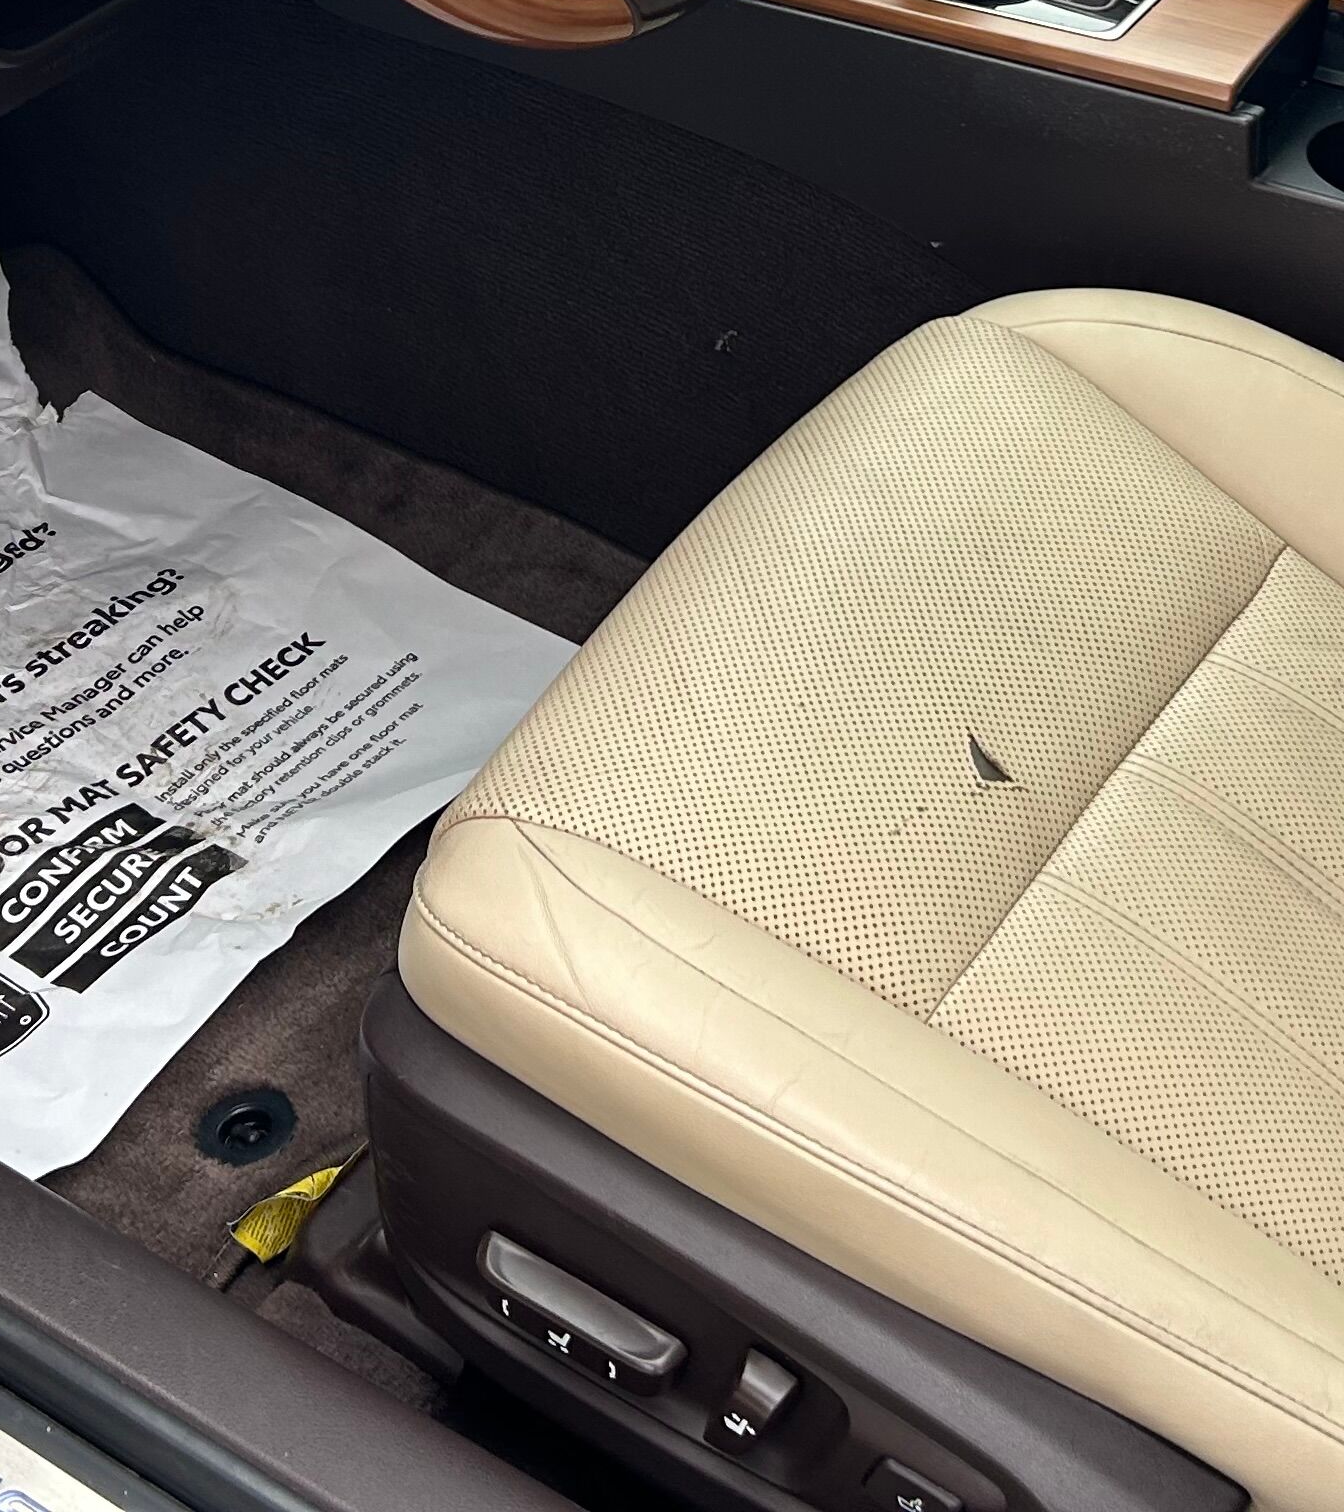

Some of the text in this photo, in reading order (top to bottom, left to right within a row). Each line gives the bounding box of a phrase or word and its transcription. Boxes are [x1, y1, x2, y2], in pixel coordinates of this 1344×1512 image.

[24, 567, 185, 679] streaking?
[39, 662, 129, 723] Manager
[126, 632, 164, 666] can
[156, 604, 206, 637] help
[1, 712, 97, 775] questions
[95, 684, 136, 720] and
[132, 647, 190, 690] more.
[45, 778, 121, 825] MAT
[115, 697, 227, 788] SAFETY
[223, 631, 327, 709] CHECK
[154, 652, 350, 805] Install only the specified floor mats
[210, 809, 235, 828] the
[273, 745, 328, 787] retention
[324, 724, 354, 749] clips
[350, 713, 367, 728] or
[364, 669, 424, 718] grommets.
[227, 650, 420, 804] mat should always be secured using
[296, 780, 323, 800] you
[316, 758, 351, 783] have
[347, 740, 373, 761] one
[368, 718, 400, 744] floor
[172, 765, 230, 813] designed
[226, 753, 248, 770] for
[244, 732, 274, 757] your
[254, 821, 279, 845] and
[319, 768, 364, 798] double
[361, 745, 395, 770] stack
[0, 817, 139, 925] CONFRM
[98, 865, 204, 959] COUNT
